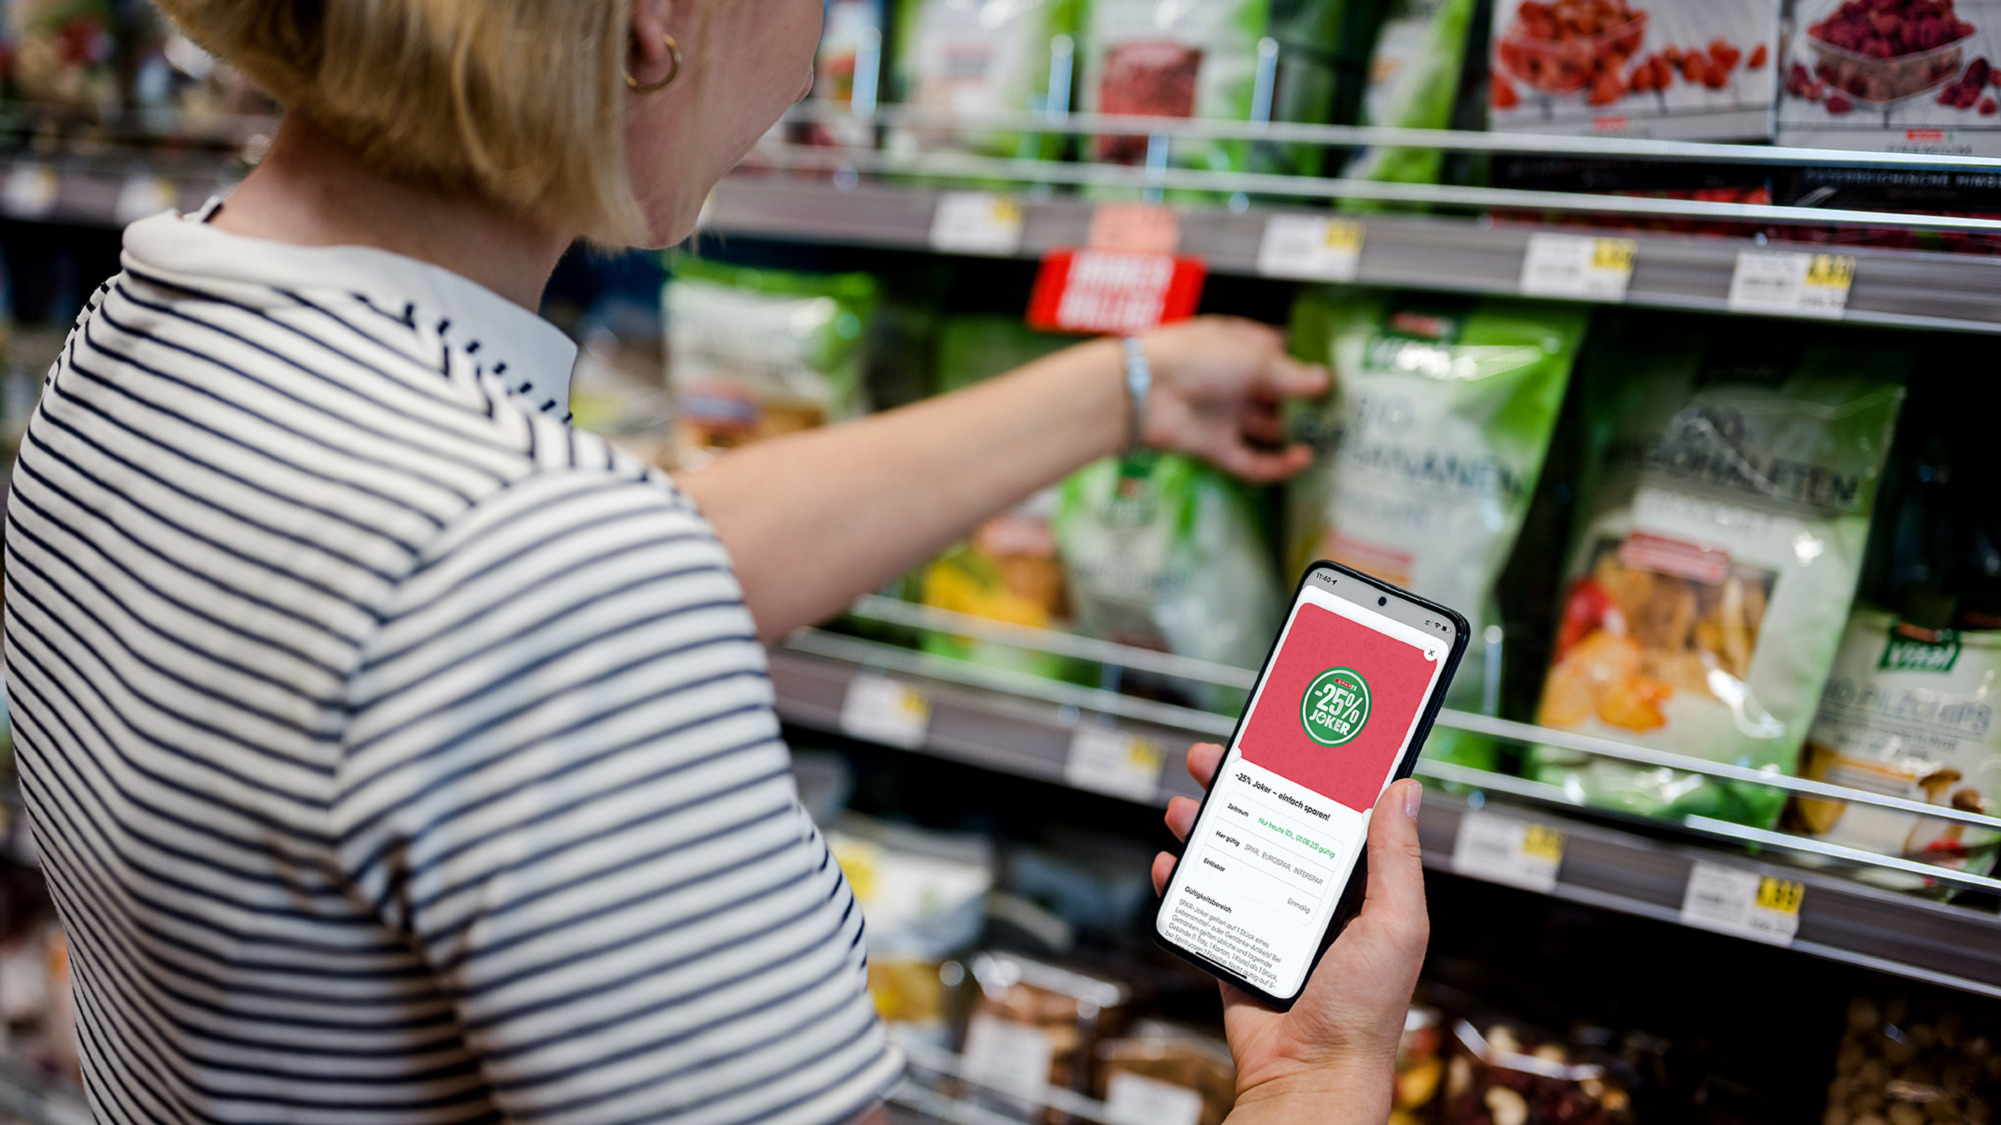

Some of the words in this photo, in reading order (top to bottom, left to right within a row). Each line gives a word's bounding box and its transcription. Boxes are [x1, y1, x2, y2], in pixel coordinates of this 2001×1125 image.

[1316, 572, 1331, 583] 11:40
[1314, 683, 1363, 724] -25%
[1309, 709, 1350, 735] JOKER
[1228, 802, 1249, 817] Zeitraum
[1235, 772, 1251, 785] -25%
[1252, 781, 1272, 793] Joker
[1278, 792, 1303, 809] einfach
[1304, 804, 1331, 821] sparen!
[1215, 830, 1226, 840] Hier
[1226, 836, 1240, 847] gültig
[1258, 817, 1268, 827] Nur
[1268, 822, 1284, 834] heute
[1318, 846, 1336, 859] gültig
[1203, 857, 1226, 872] Einlösbar
[1244, 844, 1260, 856] SPAR,
[1261, 852, 1291, 872] EUROSPAR,
[1293, 867, 1324, 886] INTERSPAR
[1184, 885, 1232, 914] Gültigkeitsbereich
[1287, 897, 1312, 914] Einmalig
